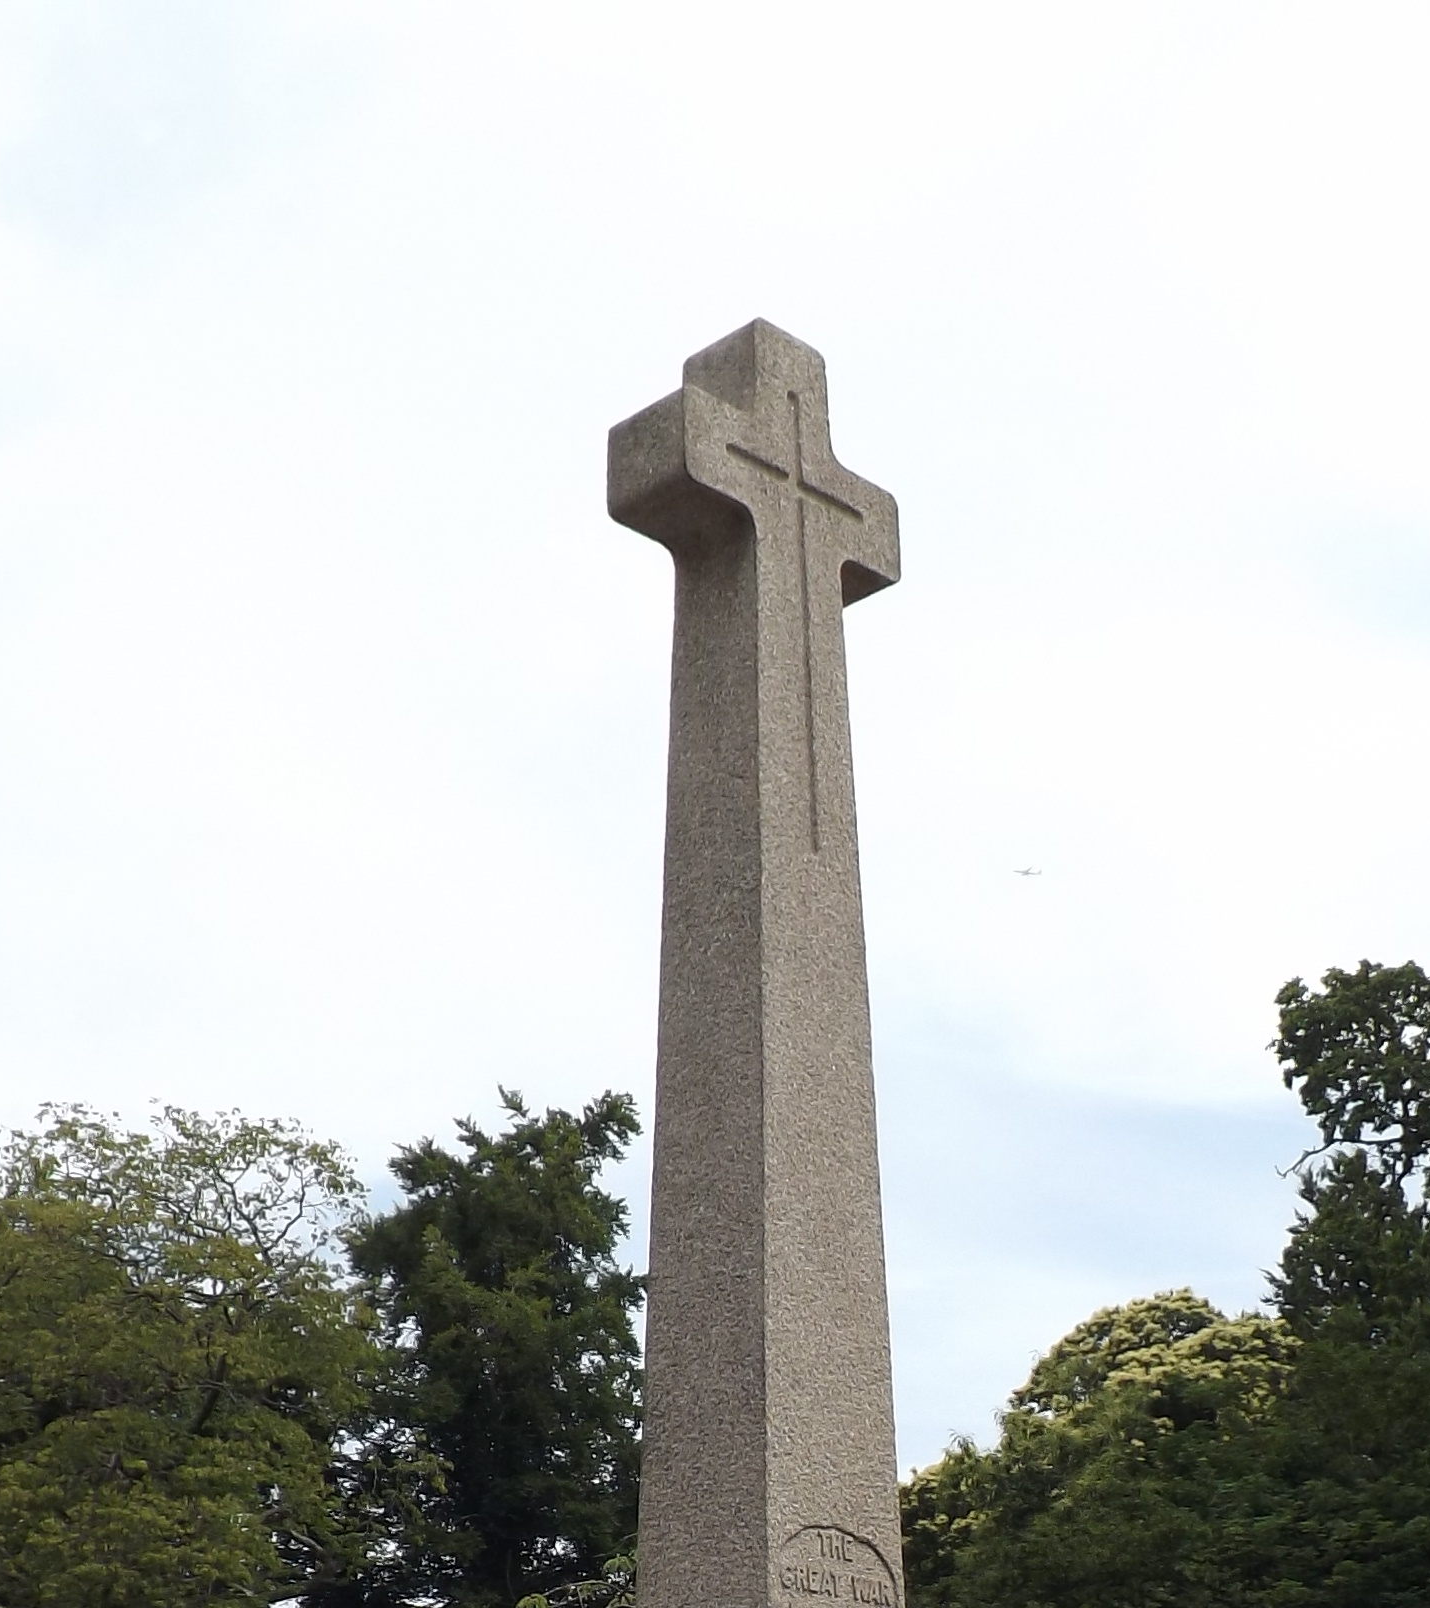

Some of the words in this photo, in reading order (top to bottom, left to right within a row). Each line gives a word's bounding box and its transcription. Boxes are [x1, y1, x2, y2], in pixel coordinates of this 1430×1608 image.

[817, 1530, 853, 1562] THE
[780, 1564, 840, 1598] GREAT
[851, 1575, 891, 1607] WAR
